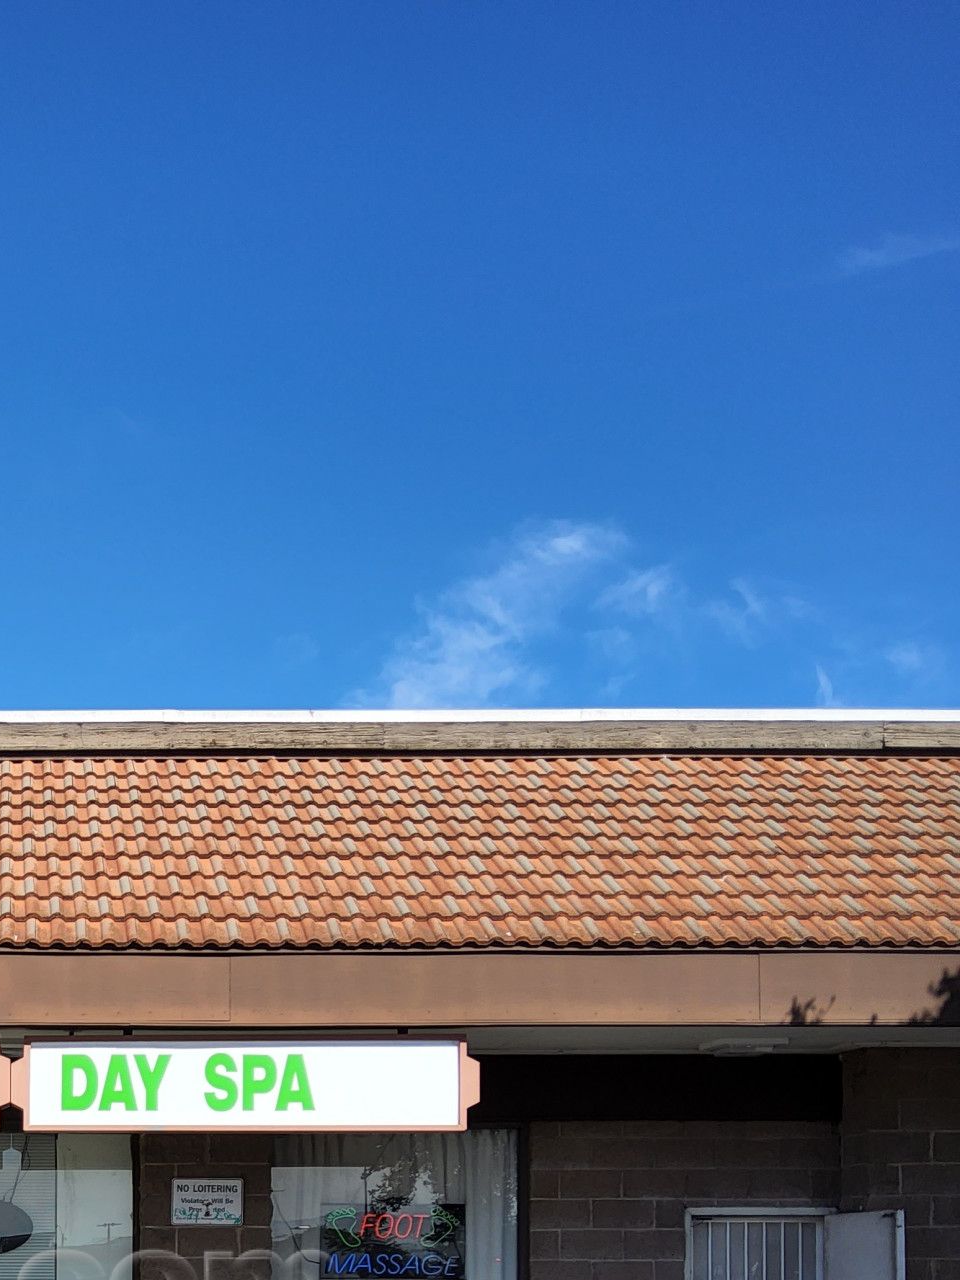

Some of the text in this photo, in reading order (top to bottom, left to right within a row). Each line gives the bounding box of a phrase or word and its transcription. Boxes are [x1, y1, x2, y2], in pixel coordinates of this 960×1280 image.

[61, 1052, 315, 1112] DAY SPA
[176, 1184, 238, 1193] NO LOITERING
[225, 1197, 234, 1205] Be
[358, 1212, 430, 1240] FOOT
[327, 1252, 460, 1276] MASSAGE
